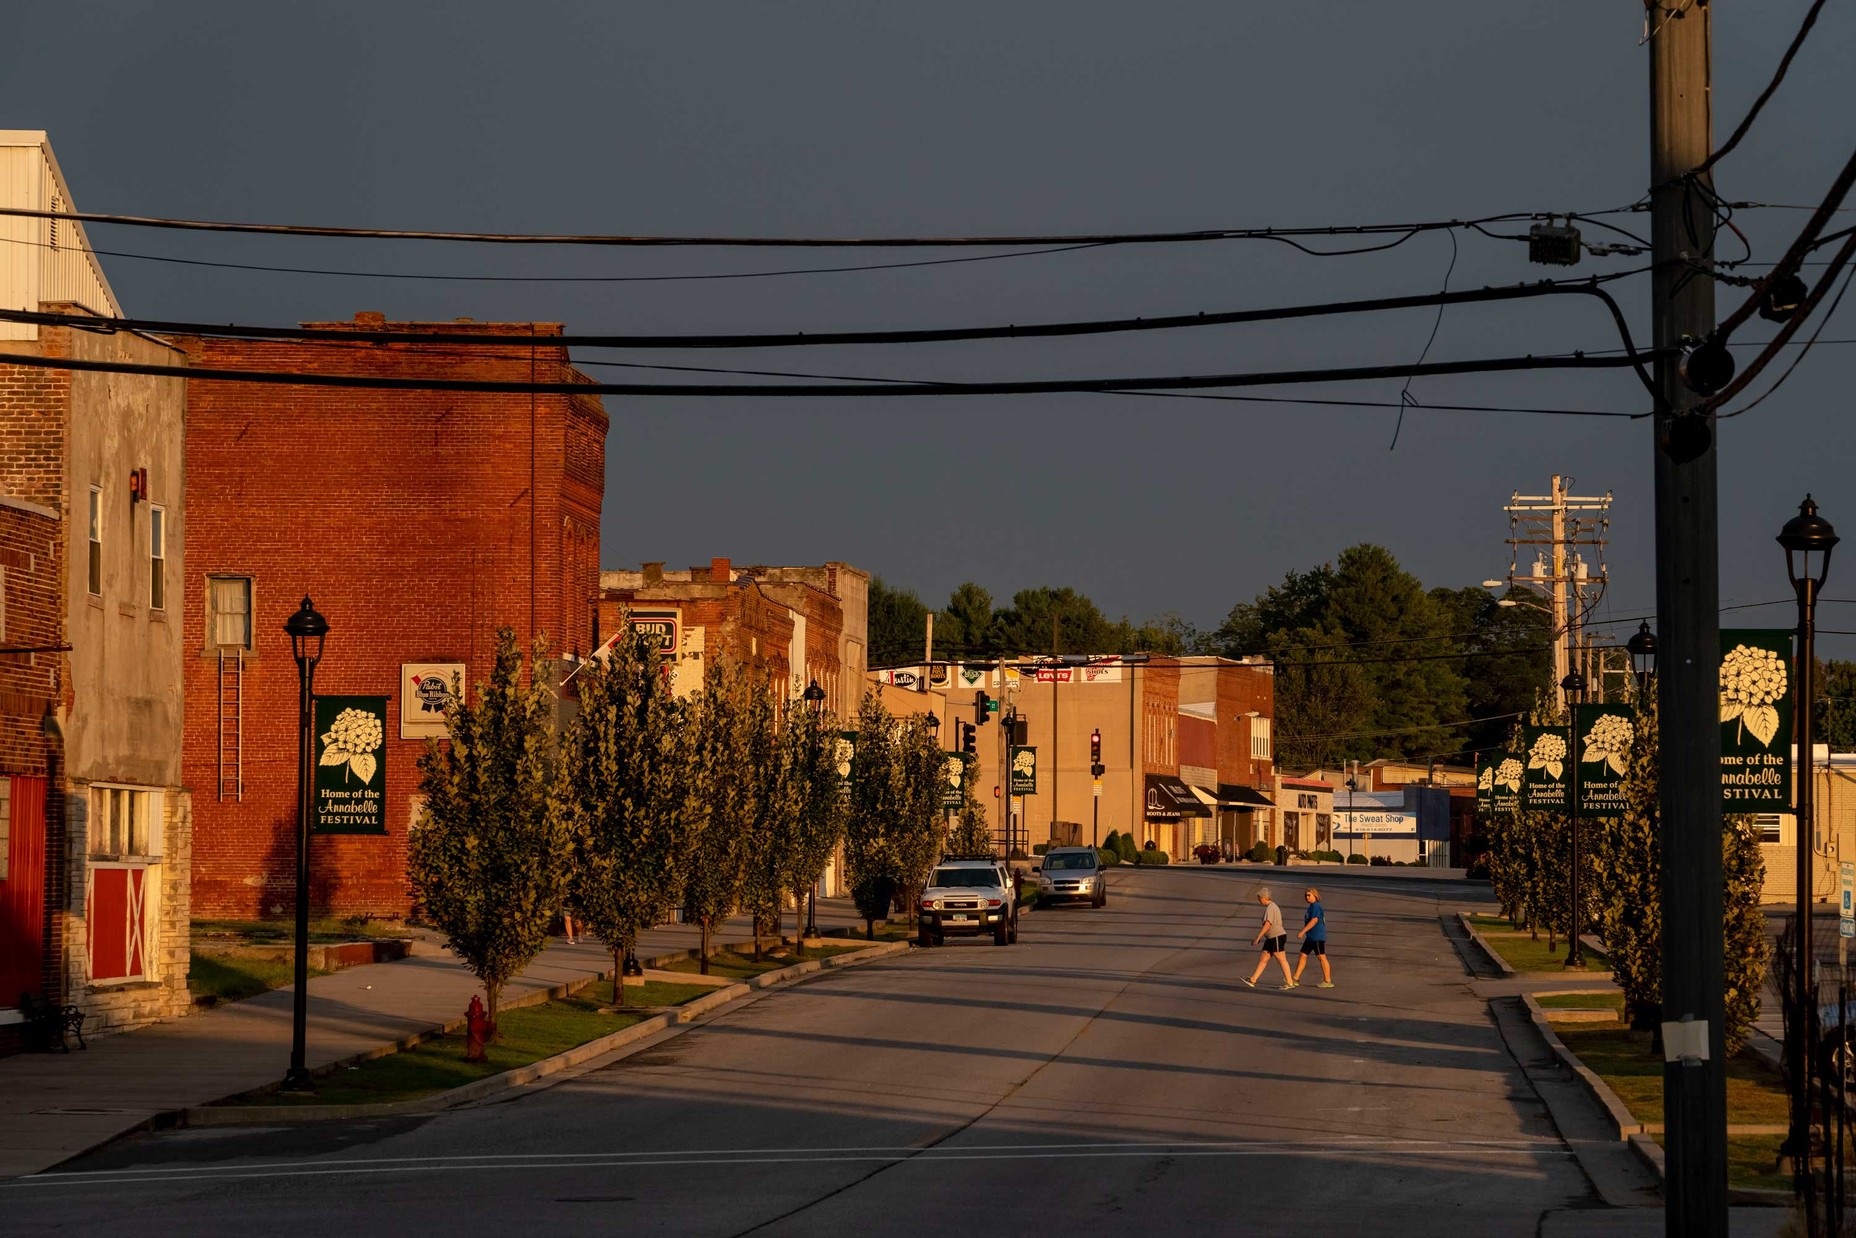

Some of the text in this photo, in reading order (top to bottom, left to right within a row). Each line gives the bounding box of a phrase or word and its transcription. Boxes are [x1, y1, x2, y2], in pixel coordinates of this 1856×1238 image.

[635, 623, 667, 634] BUD
[422, 680, 442, 690] Pabst
[416, 690, 450, 698] Blue Ribbon
[1746, 753, 1760, 765] of
[1763, 754, 1784, 765] the
[1721, 768, 1782, 785] nnabelle
[1609, 780, 1618, 788] of
[321, 789, 380, 798] Home of the
[1528, 789, 1564, 798] Annabelle
[1581, 790, 1627, 801] Annabell
[1723, 788, 1782, 799] STIVAL
[318, 799, 378, 814] Annabelle
[320, 816, 378, 824] FESTIVAL
[1344, 814, 1404, 824] The Sweat Shop
